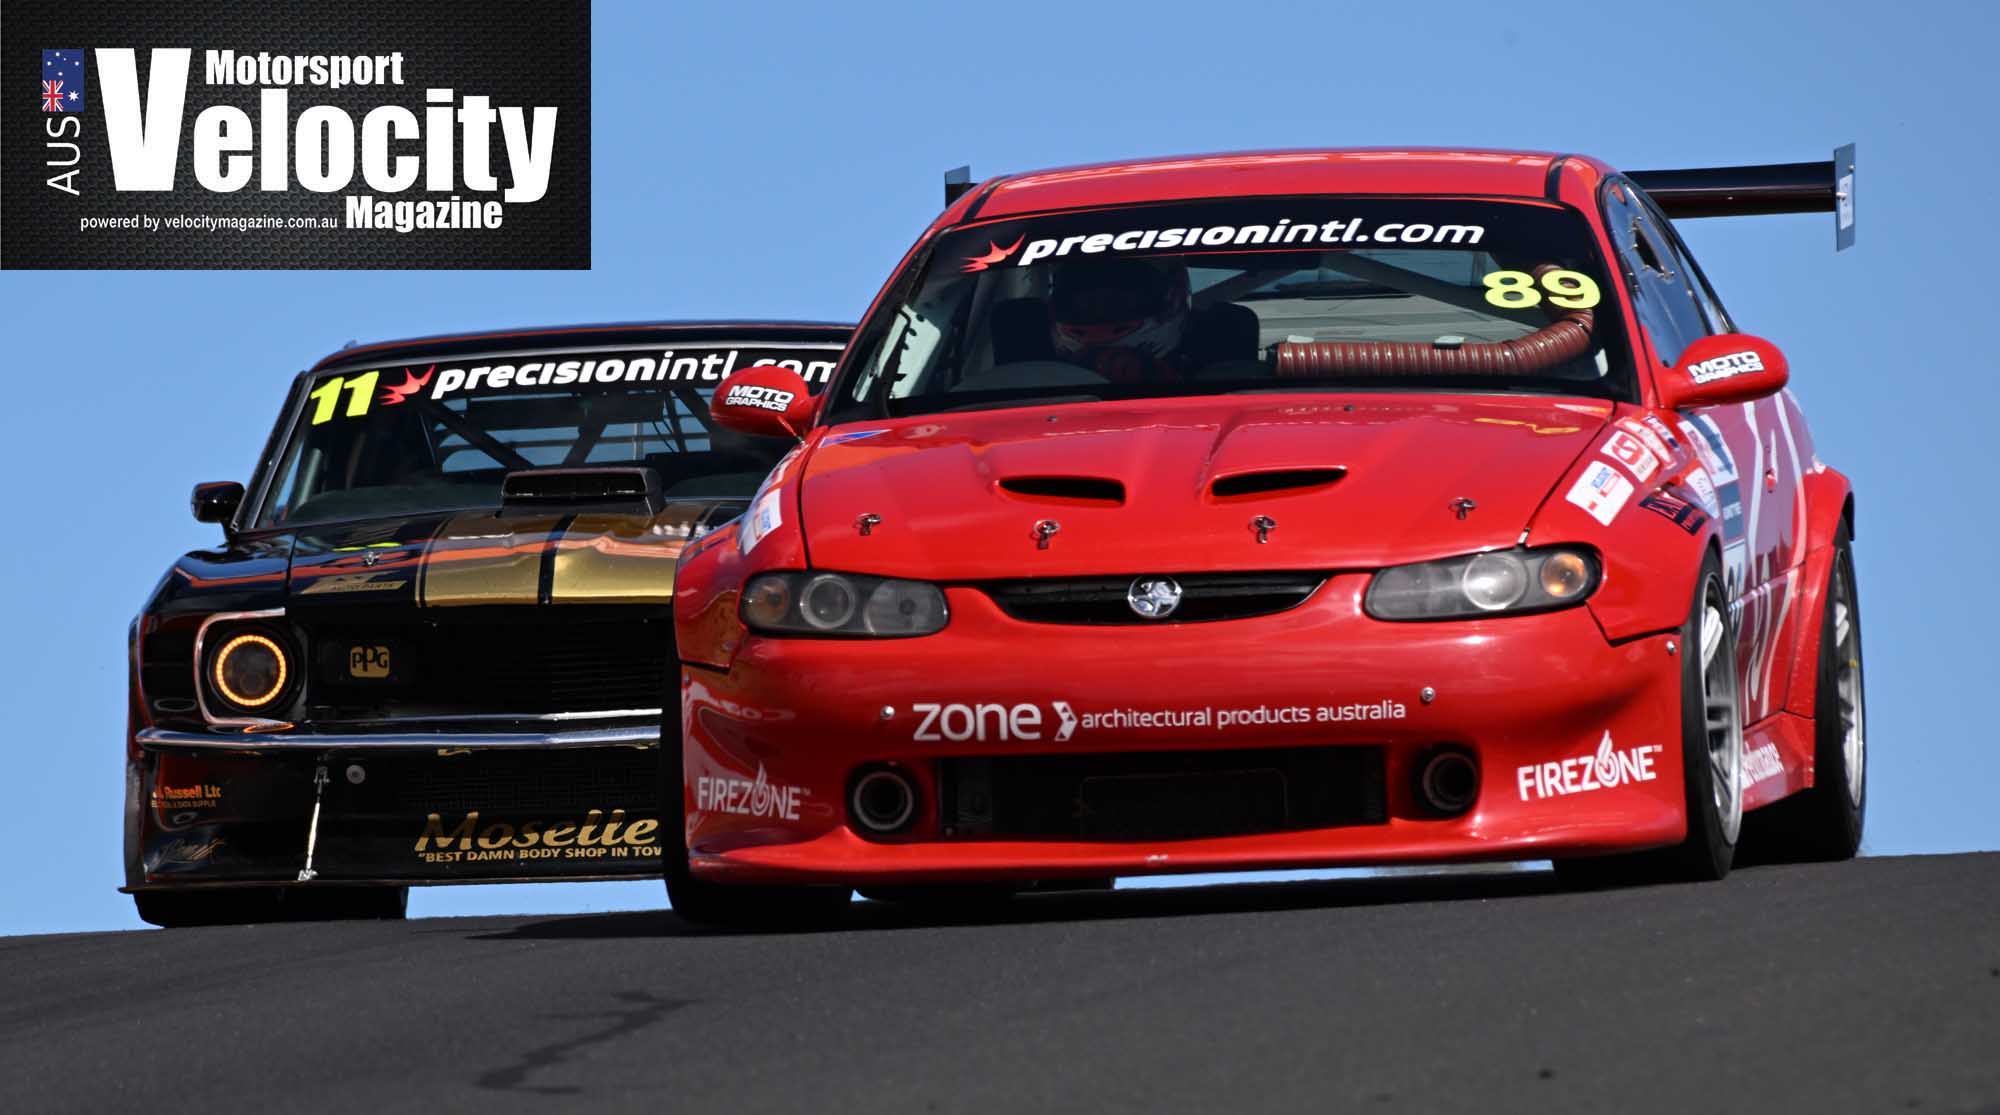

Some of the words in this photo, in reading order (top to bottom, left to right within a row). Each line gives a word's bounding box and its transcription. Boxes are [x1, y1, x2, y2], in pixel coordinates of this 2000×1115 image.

[1017, 217, 1485, 266] precisionintl.com
[1483, 269, 1601, 309] 89
[430, 350, 837, 400] precisionintlm
[1688, 351, 1760, 377] MOTO
[310, 371, 379, 425] 11
[725, 396, 788, 412] GRAPHICS
[728, 385, 795, 403] MOTO
[352, 646, 388, 672] PPG
[912, 703, 1042, 740] zone
[1081, 707, 1211, 728] architectural
[1217, 704, 1311, 730] products
[1316, 699, 1406, 722] australia
[466, 850, 514, 861] DAMN
[519, 848, 561, 859] BODY
[565, 847, 607, 858] SHOP
[611, 847, 628, 858] IN
